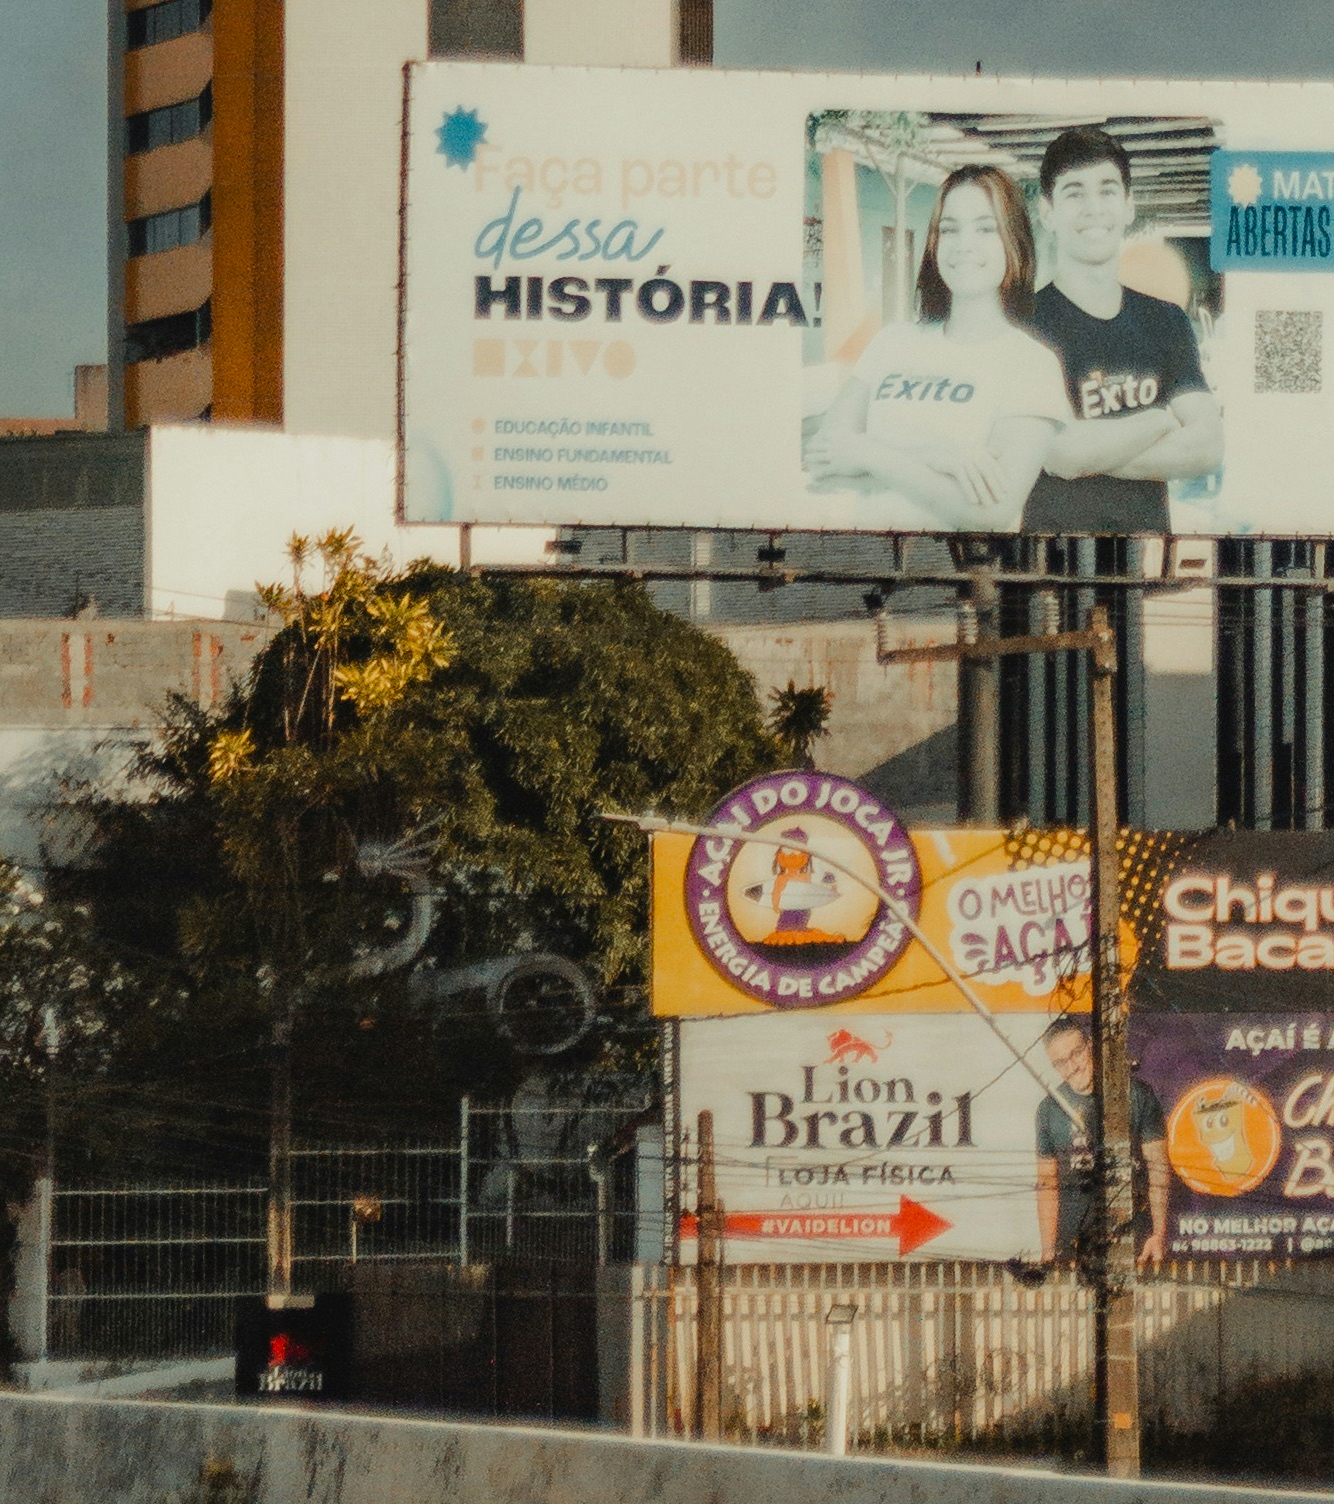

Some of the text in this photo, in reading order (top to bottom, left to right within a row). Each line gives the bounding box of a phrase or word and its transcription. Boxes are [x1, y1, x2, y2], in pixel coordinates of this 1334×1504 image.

[474, 143, 778, 211] Faça parte
[473, 184, 664, 271] dessa
[1226, 204, 1331, 257] ABERTAS
[473, 264, 823, 330] HISTÓRIA!
[494, 416, 655, 438] EDUCAÇÃO INFANTIL
[494, 447, 673, 465] ENSINO FUNDAMENTAL
[494, 472, 609, 492] ENSINO MÉDIO
[751, 780, 808, 816] DO
[814, 782, 894, 847] JOCA
[880, 848, 914, 887] JR
[958, 874, 1091, 920] O MELHO
[698, 902, 772, 991] ENERGIA
[777, 976, 814, 998] DE
[1225, 1021, 1297, 1057] AÇAÍ
[1303, 1023, 1321, 1051] É
[799, 1064, 918, 1105] Lion
[746, 1090, 978, 1149] Brazil
[778, 1160, 956, 1186] LOJA FÍSICA
[760, 1218, 892, 1234] #VAIDELION
[1179, 1217, 1209, 1235] NO
[1213, 1216, 1297, 1235] MELHOR
